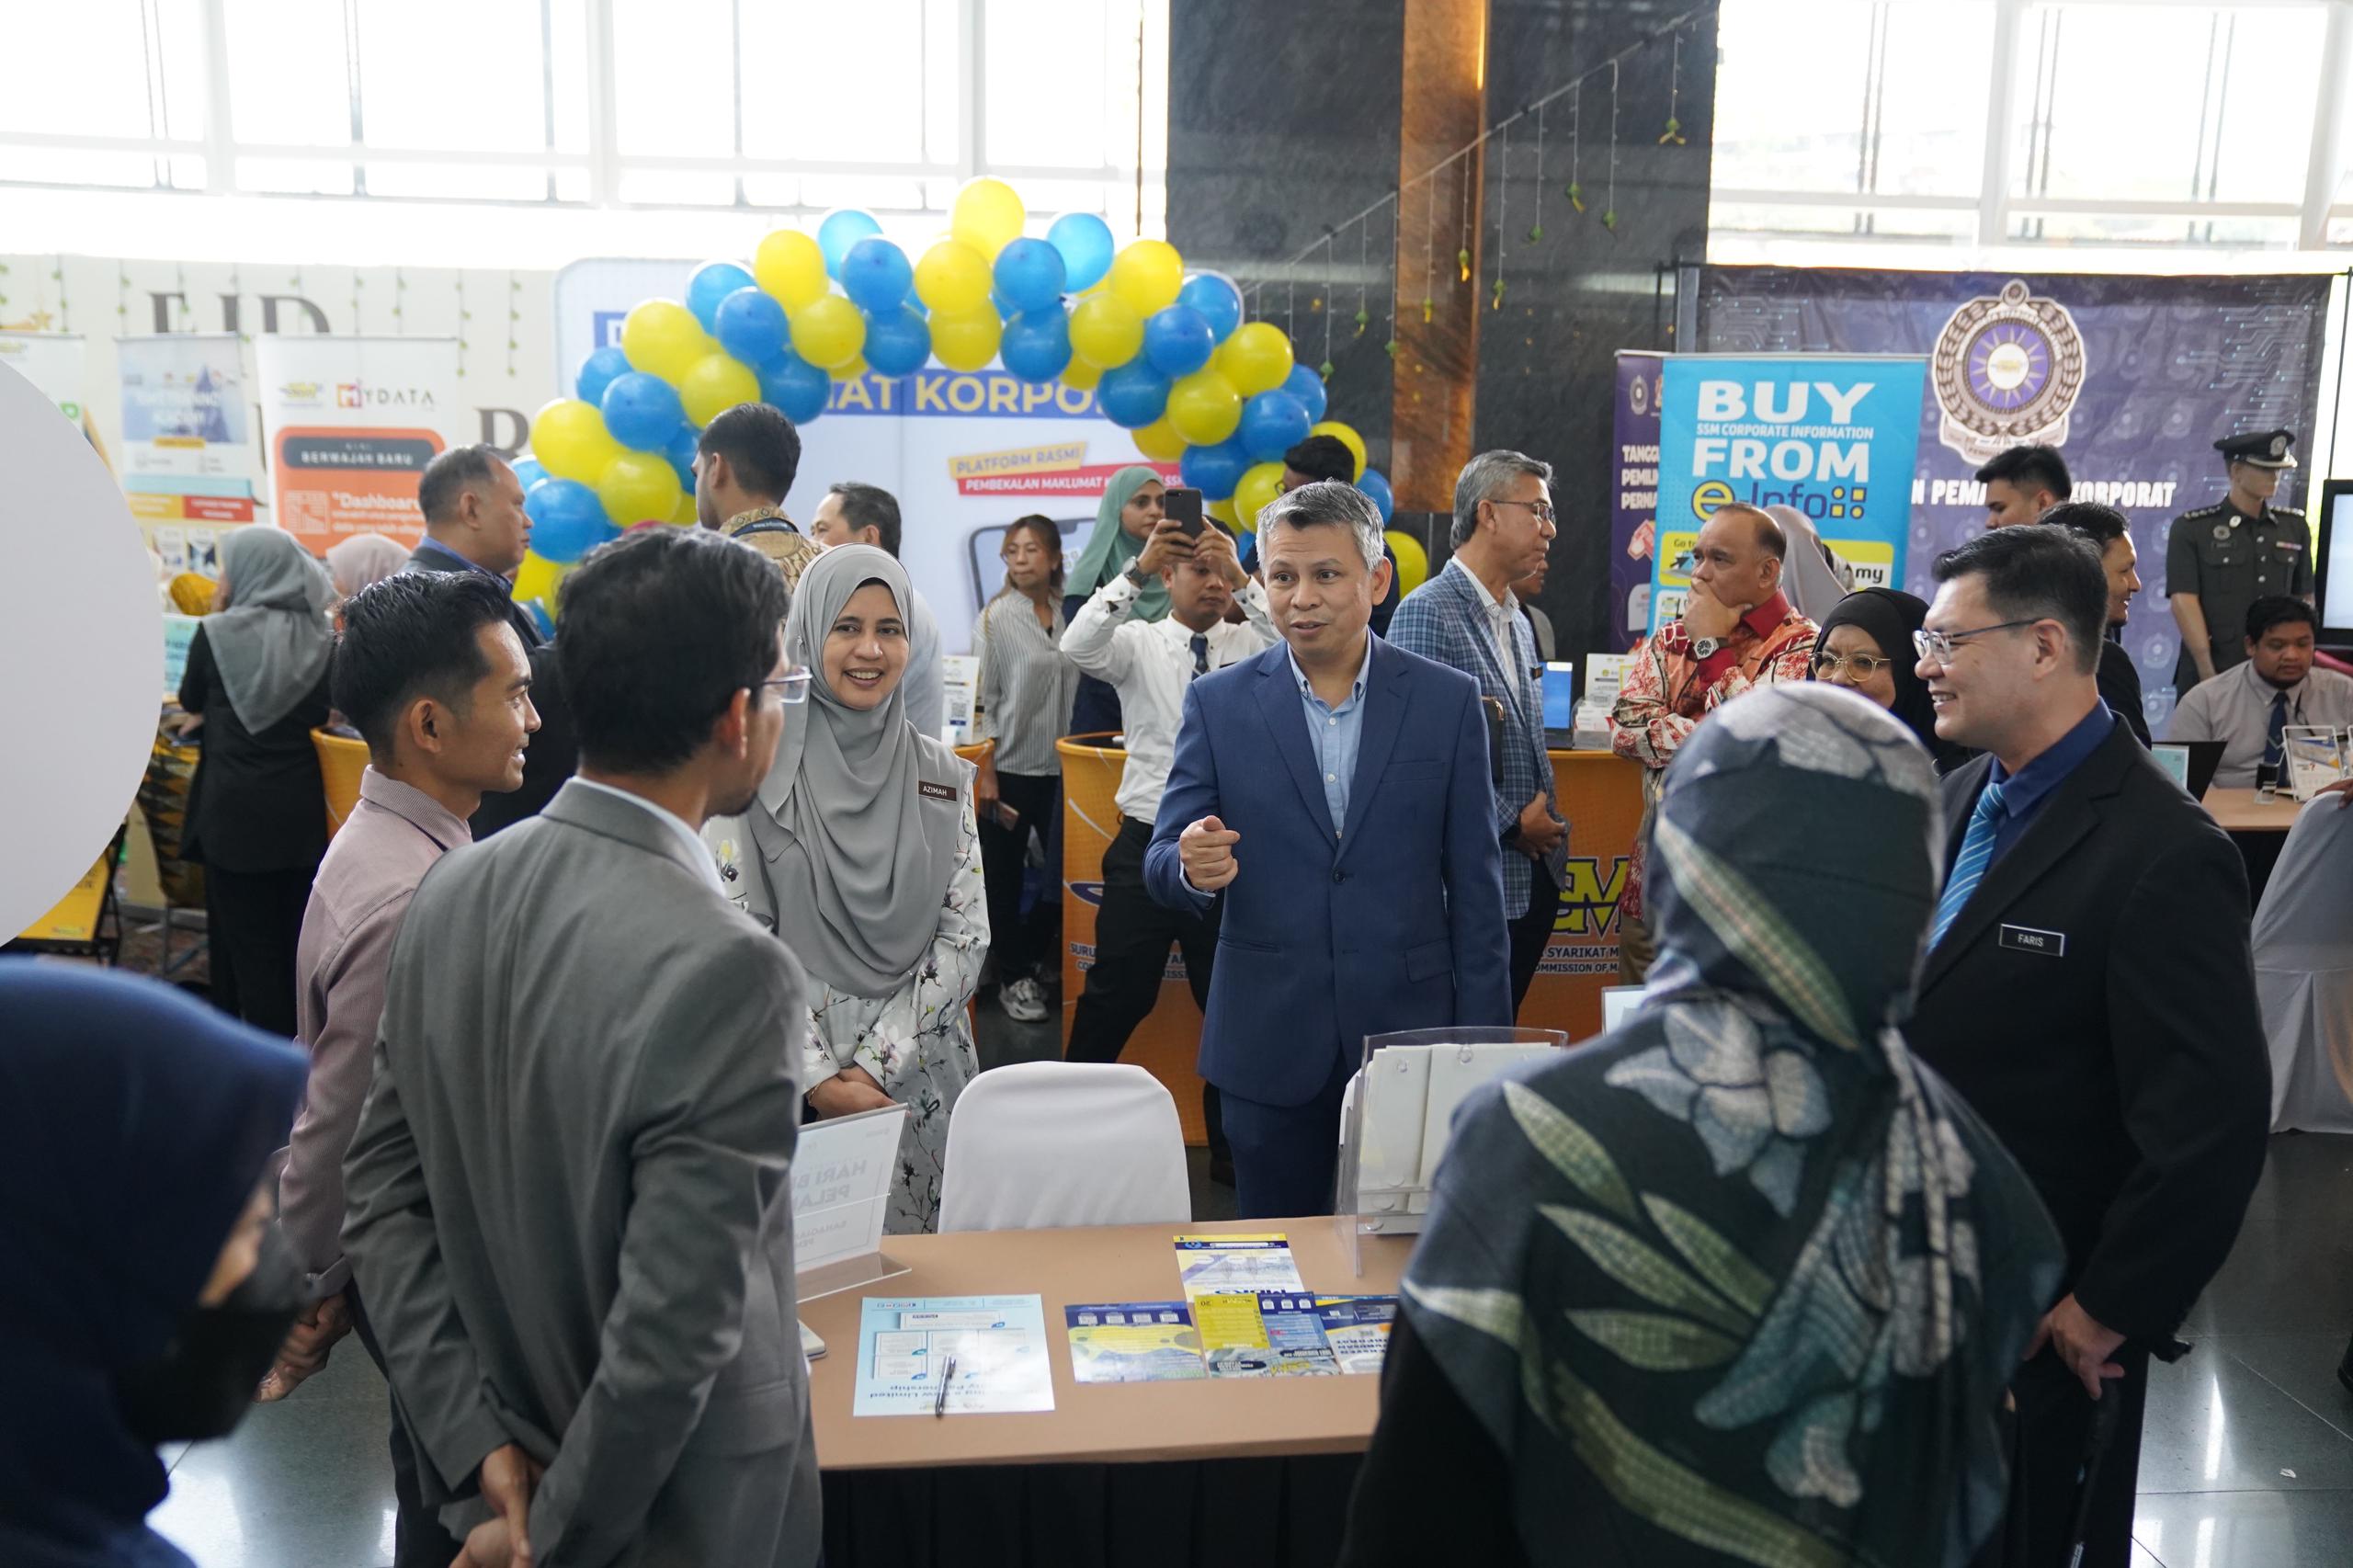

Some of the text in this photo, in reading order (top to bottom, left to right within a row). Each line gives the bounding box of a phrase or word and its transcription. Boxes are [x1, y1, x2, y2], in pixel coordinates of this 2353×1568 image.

[827, 375, 1103, 414] AT KORPO
[1697, 380, 1876, 425] BUY
[1697, 423, 1874, 439] SSM CORPORATE INFORMATION
[956, 447, 1080, 473] PLATFORM RASMI
[1621, 445, 1660, 463] TANGG
[1692, 437, 1870, 483] FROM
[966, 477, 1040, 491] PEMBEKALAN
[1041, 475, 1102, 490] MAKLUMAT
[1674, 539, 1686, 548] Go
[923, 785, 948, 797] AZIMAH
[2018, 933, 2044, 948] FARIS
[1547, 948, 1606, 958] SYARIKAT
[1535, 963, 1592, 972] OMMISSION
